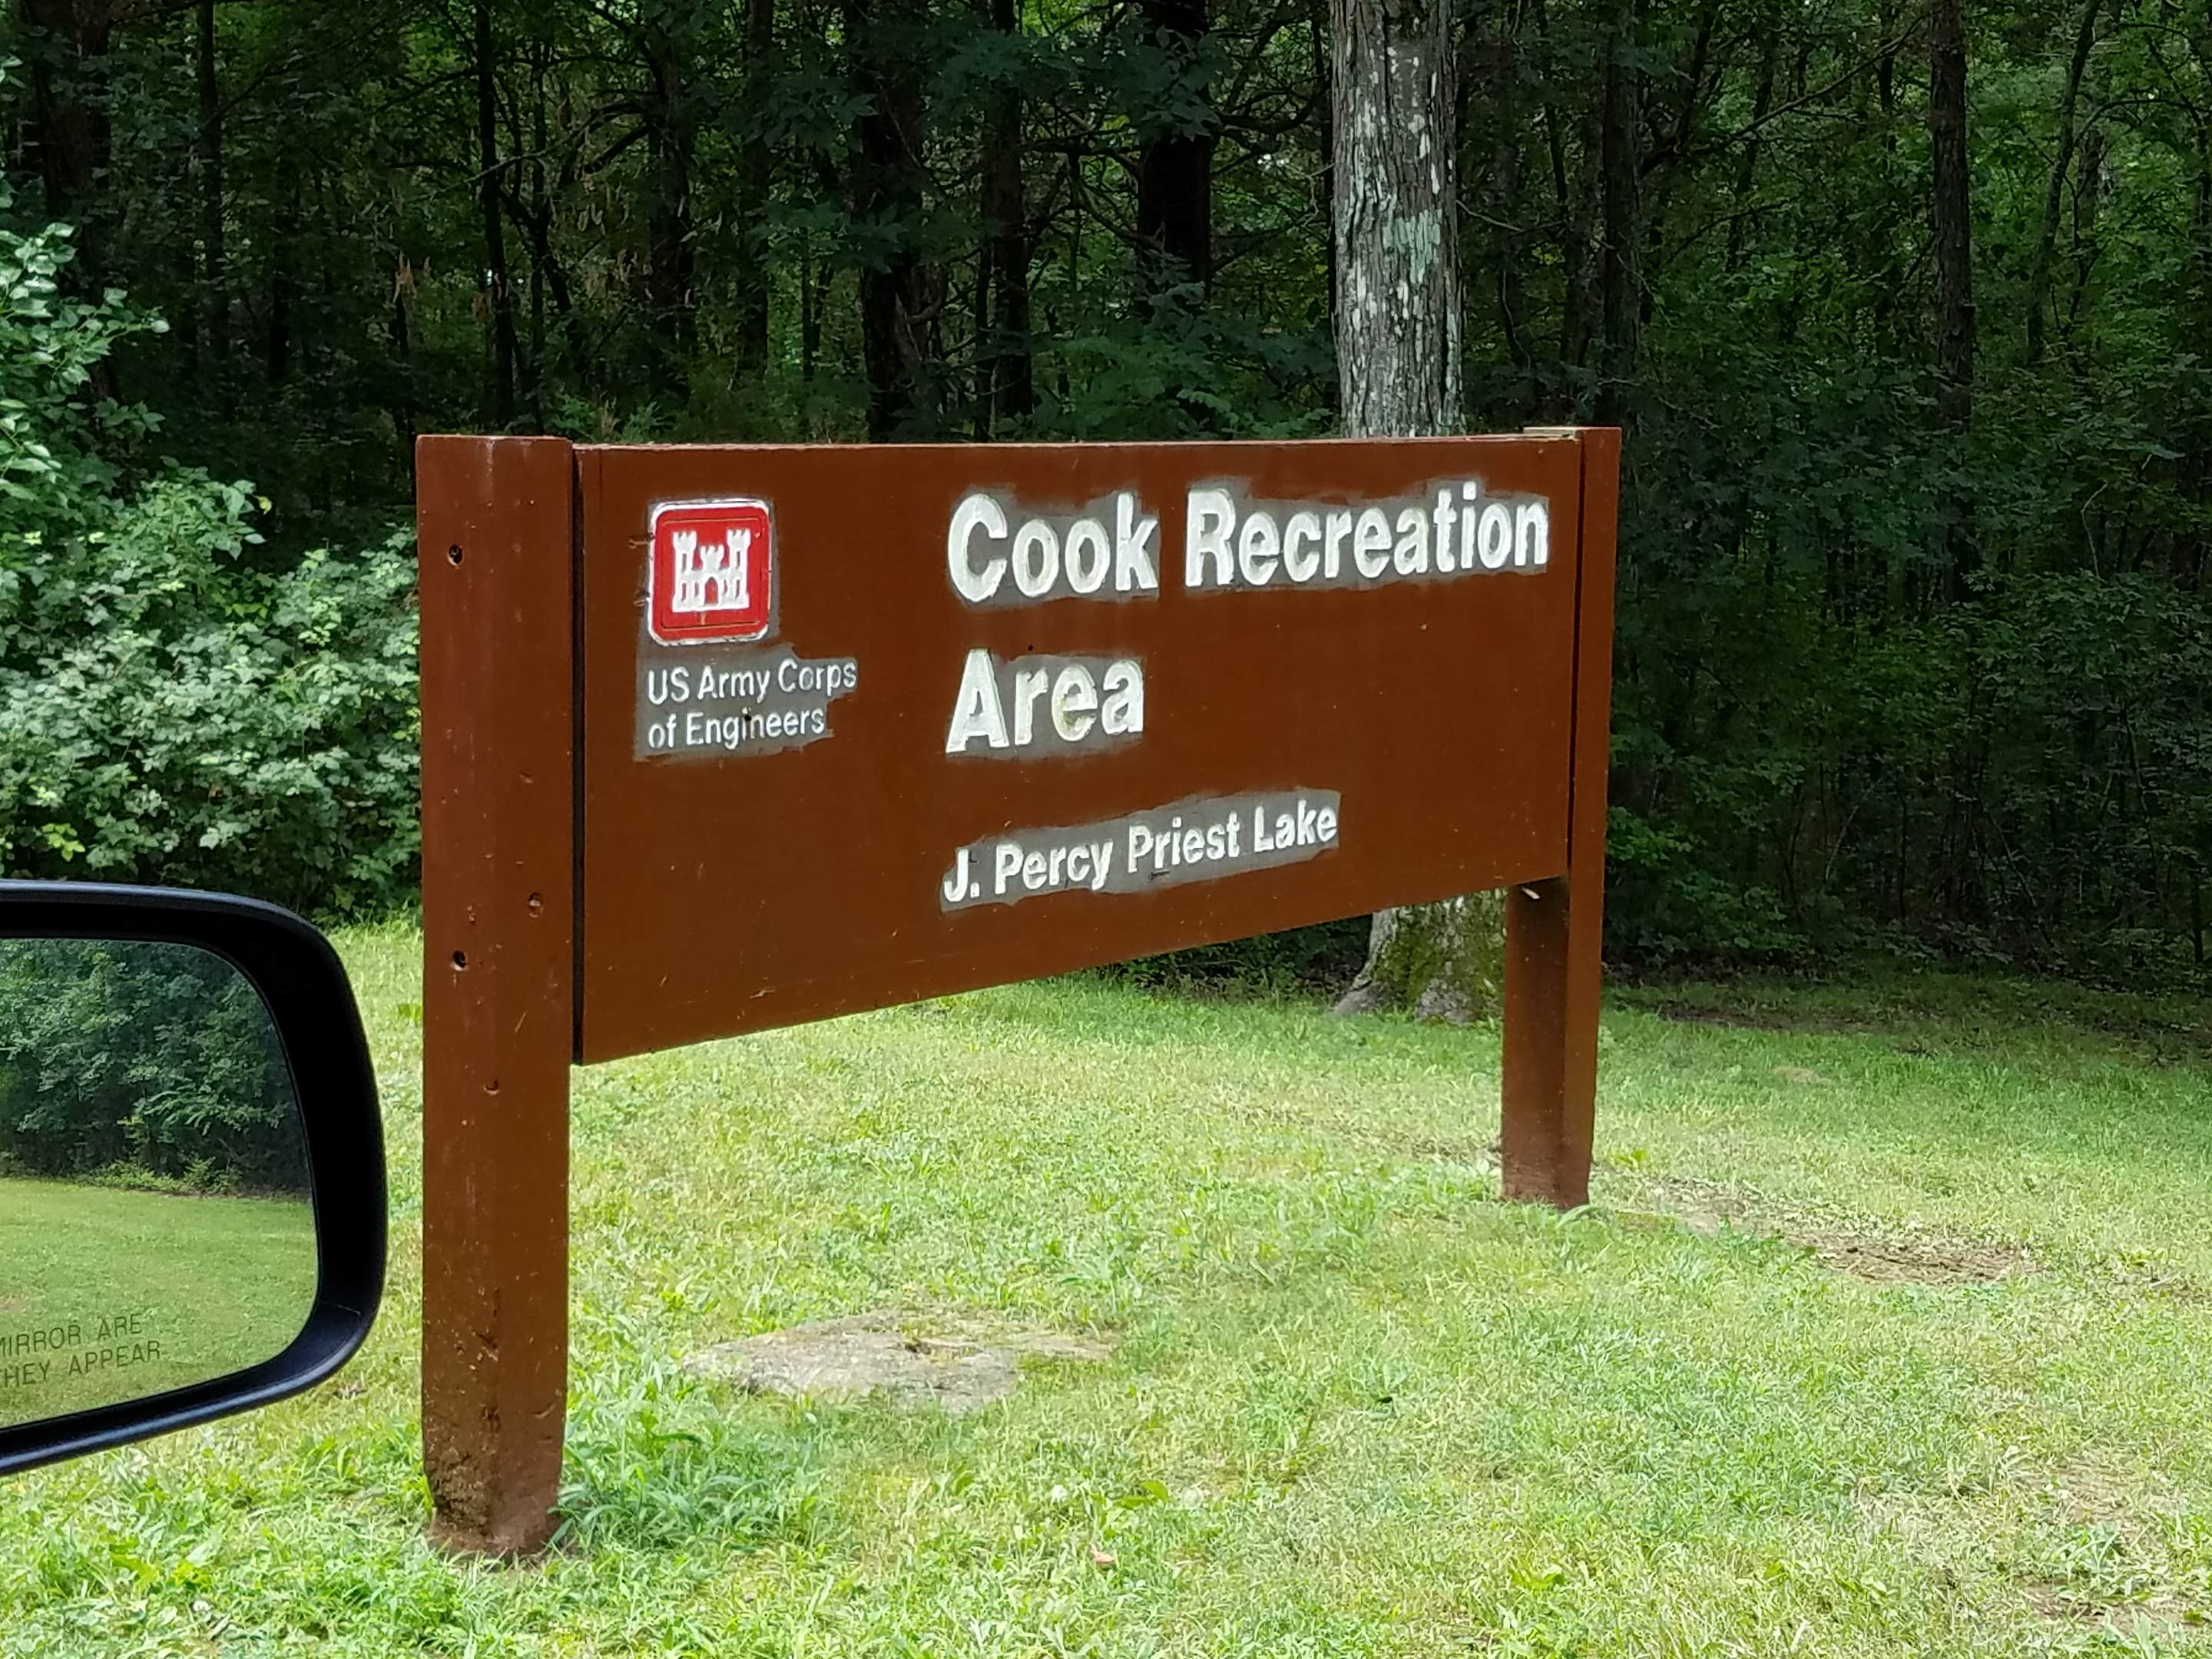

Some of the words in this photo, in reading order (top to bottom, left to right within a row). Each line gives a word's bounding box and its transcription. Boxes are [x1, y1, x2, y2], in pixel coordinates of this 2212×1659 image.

[947, 492, 1158, 602] Cook
[1185, 482, 1549, 587] Recreation
[648, 666, 689, 704] US
[697, 664, 770, 703] Army
[778, 658, 856, 696] Corps
[945, 648, 1144, 753] Area
[648, 714, 676, 748] of
[686, 707, 825, 750] Engineers
[944, 849, 979, 902] J.
[995, 841, 1113, 895] Percy
[1128, 812, 1240, 873] Priest
[1253, 800, 1338, 853] Lake
[96, 1313, 142, 1341] ARE
[0, 1359, 50, 1388] HEY
[68, 1340, 160, 1376] APPEAR
